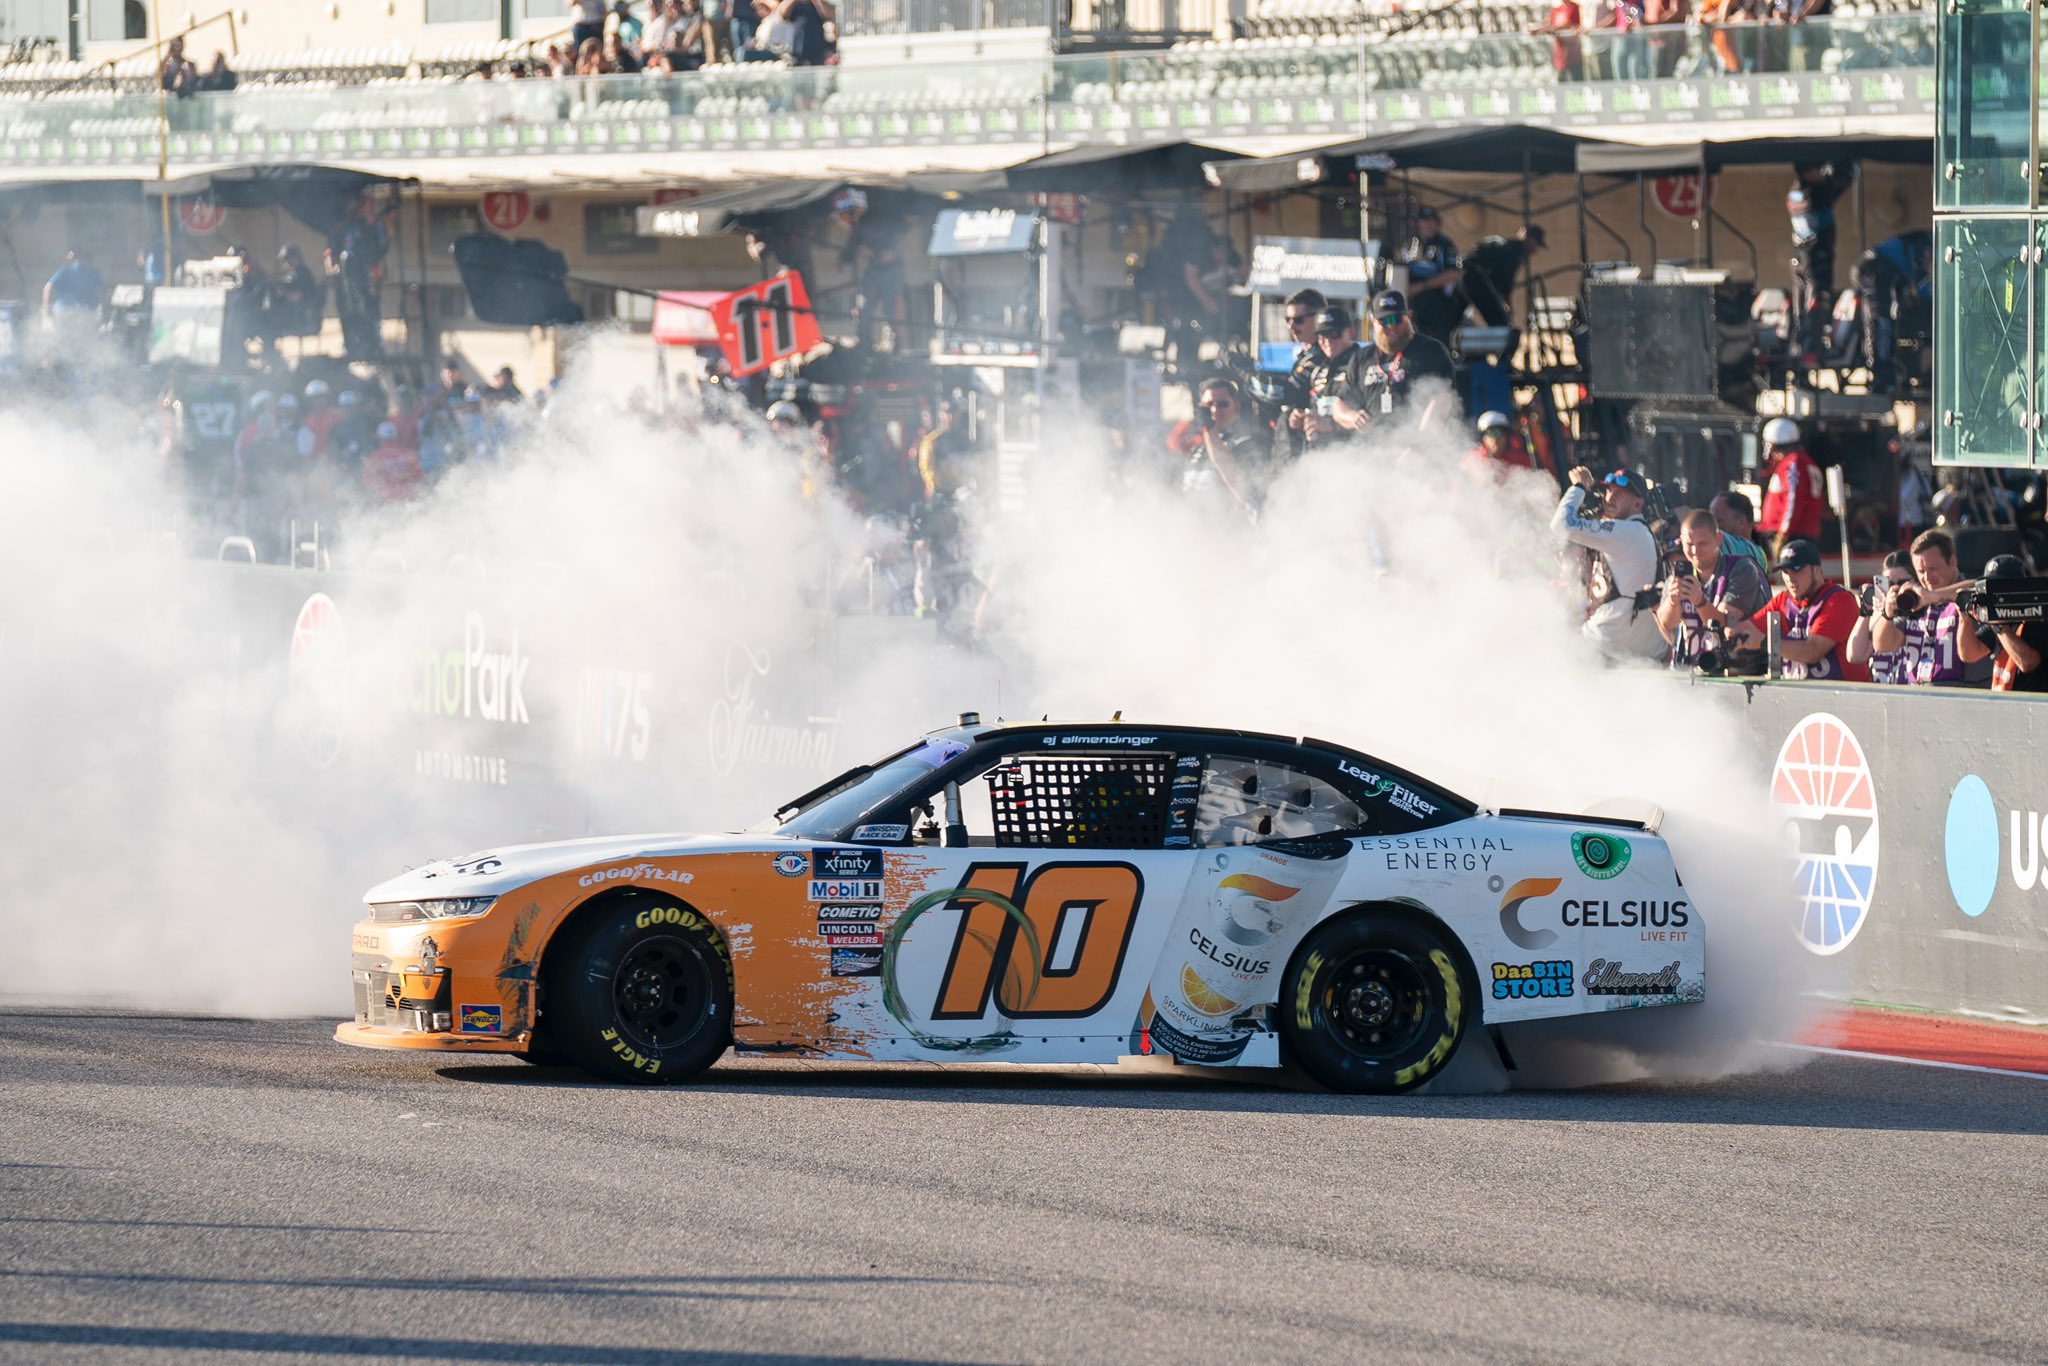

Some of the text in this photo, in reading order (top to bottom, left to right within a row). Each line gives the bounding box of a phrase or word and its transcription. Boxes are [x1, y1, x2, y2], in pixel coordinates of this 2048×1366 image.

[495, 194, 517, 225] 21
[730, 279, 797, 371] 11
[191, 402, 237, 436] 27
[1995, 605, 2043, 618] WHELEN
[1043, 735, 1158, 746] aj allmendinger
[415, 750, 507, 786] AUTOMOTIVE
[1338, 760, 1438, 815] Leaf Filter
[1388, 799, 1424, 819] PROTECTION
[1361, 837, 1513, 851] ESSENTIAL
[2011, 810, 2048, 890] U
[825, 856, 871, 872] xfinity
[1259, 852, 1288, 867] ORANGE
[1386, 852, 1492, 871] ENERGY
[578, 863, 694, 887] GOODYEAR
[812, 882, 859, 896] Mobil
[819, 907, 881, 918] COMETIC
[1562, 899, 1689, 928] CELSIUS
[820, 925, 873, 934] LINCOLN
[1641, 931, 1688, 941] LIVE FIT
[833, 936, 879, 944] WELDERS
[930, 860, 1145, 1020] 10
[1189, 928, 1271, 974] CELSIUS
[1231, 971, 1249, 980] LIVE
[1492, 960, 1573, 979] DaaBIN
[1582, 958, 1682, 988] Ellsworth
[1492, 978, 1574, 999] STORE
[463, 1014, 500, 1024] SUNOCO
[600, 1026, 662, 1074] EAGLE
[1190, 1041, 1218, 1050] ENERGY
